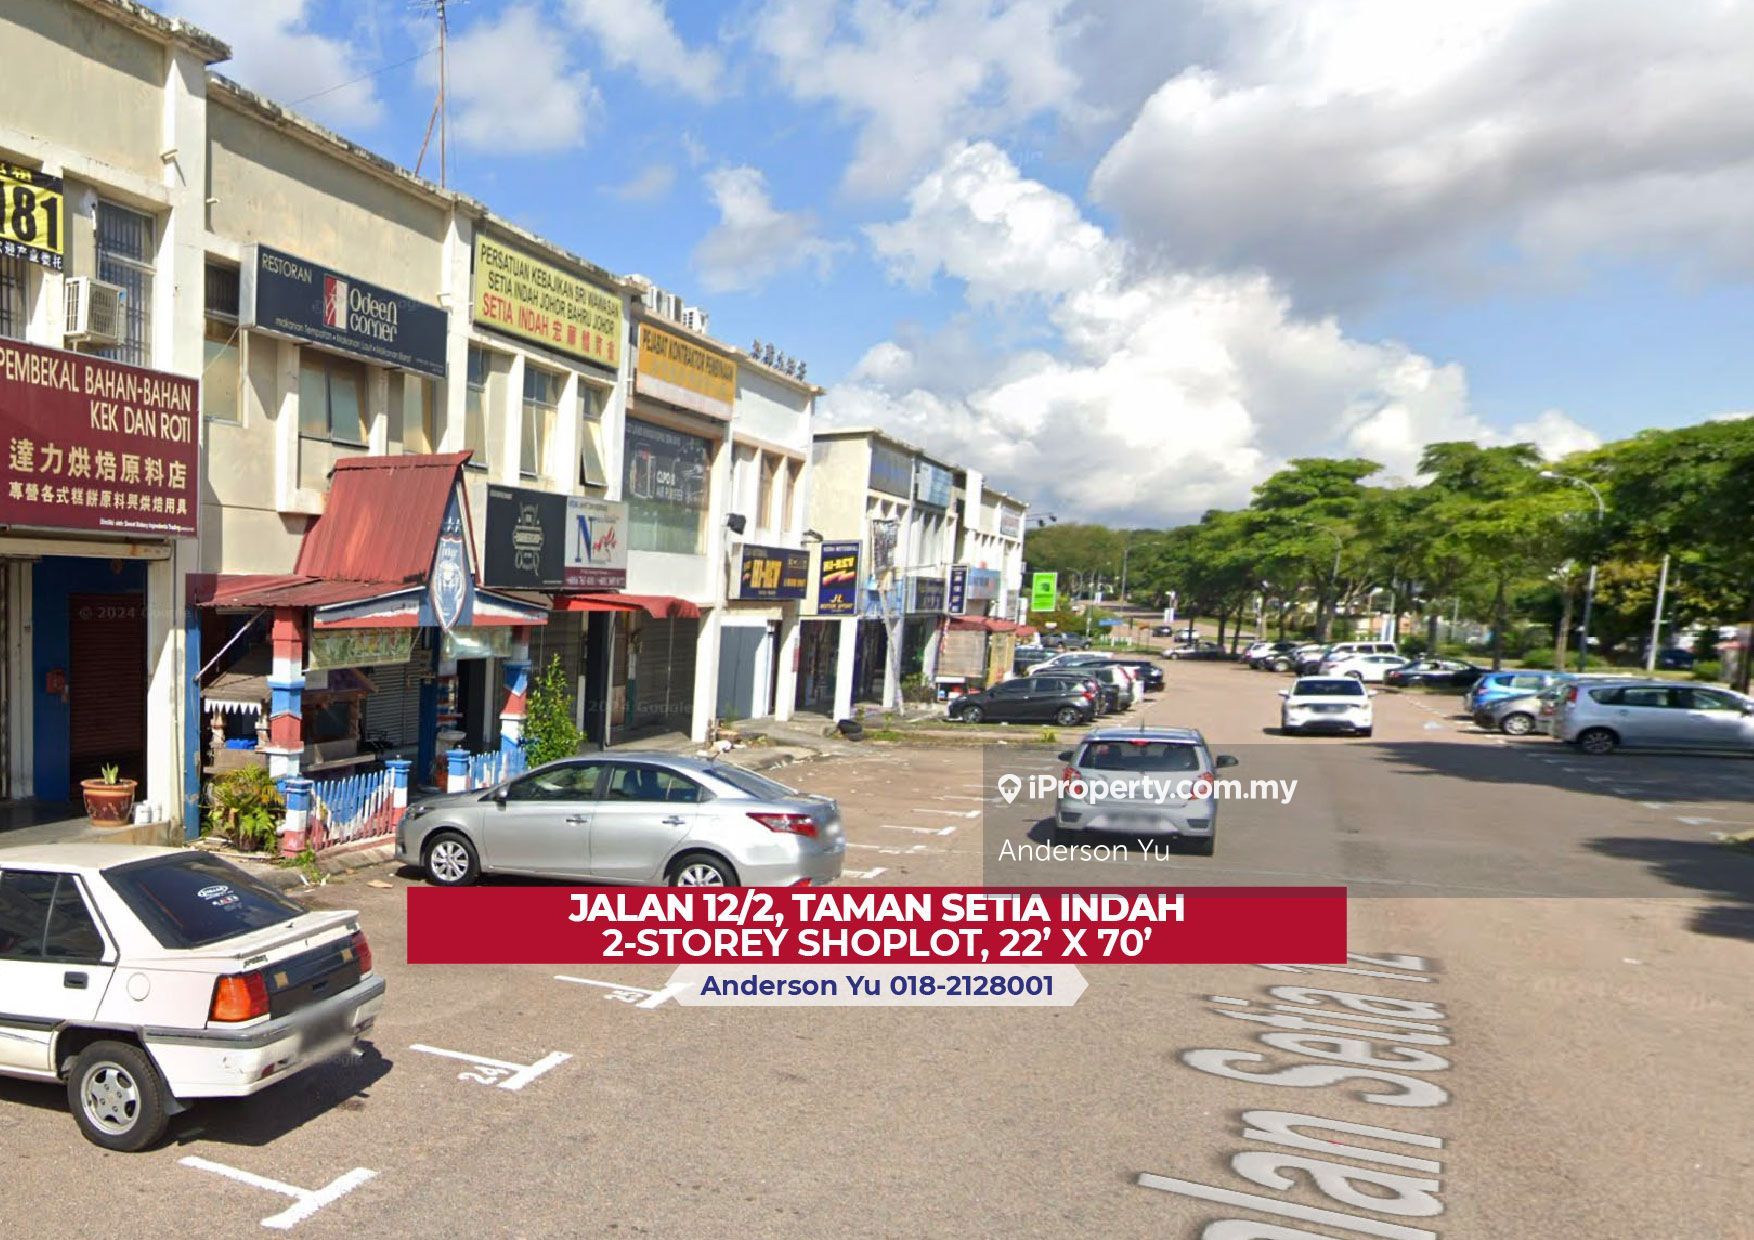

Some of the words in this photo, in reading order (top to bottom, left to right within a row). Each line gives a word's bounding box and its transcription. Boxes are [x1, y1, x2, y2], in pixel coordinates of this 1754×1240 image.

[0, 182, 57, 250] 81
[262, 253, 312, 284] RESTORAN
[481, 243, 529, 281] PERSATUAN
[531, 265, 573, 300] KEBAJIKAN
[350, 288, 398, 326] Odeen
[483, 292, 513, 324] SETIA
[519, 306, 549, 336] INDAH
[488, 271, 512, 295] SETIA
[514, 281, 538, 306] INDAH
[540, 293, 565, 317] JOHOR
[567, 303, 591, 327] BAHRU
[593, 312, 615, 334] JOHOR
[350, 313, 398, 343] corner
[85, 366, 191, 411] BAHAN-BAHAN
[90, 400, 118, 432] KEK
[124, 406, 156, 438] DAN
[161, 412, 191, 444] ROTI
